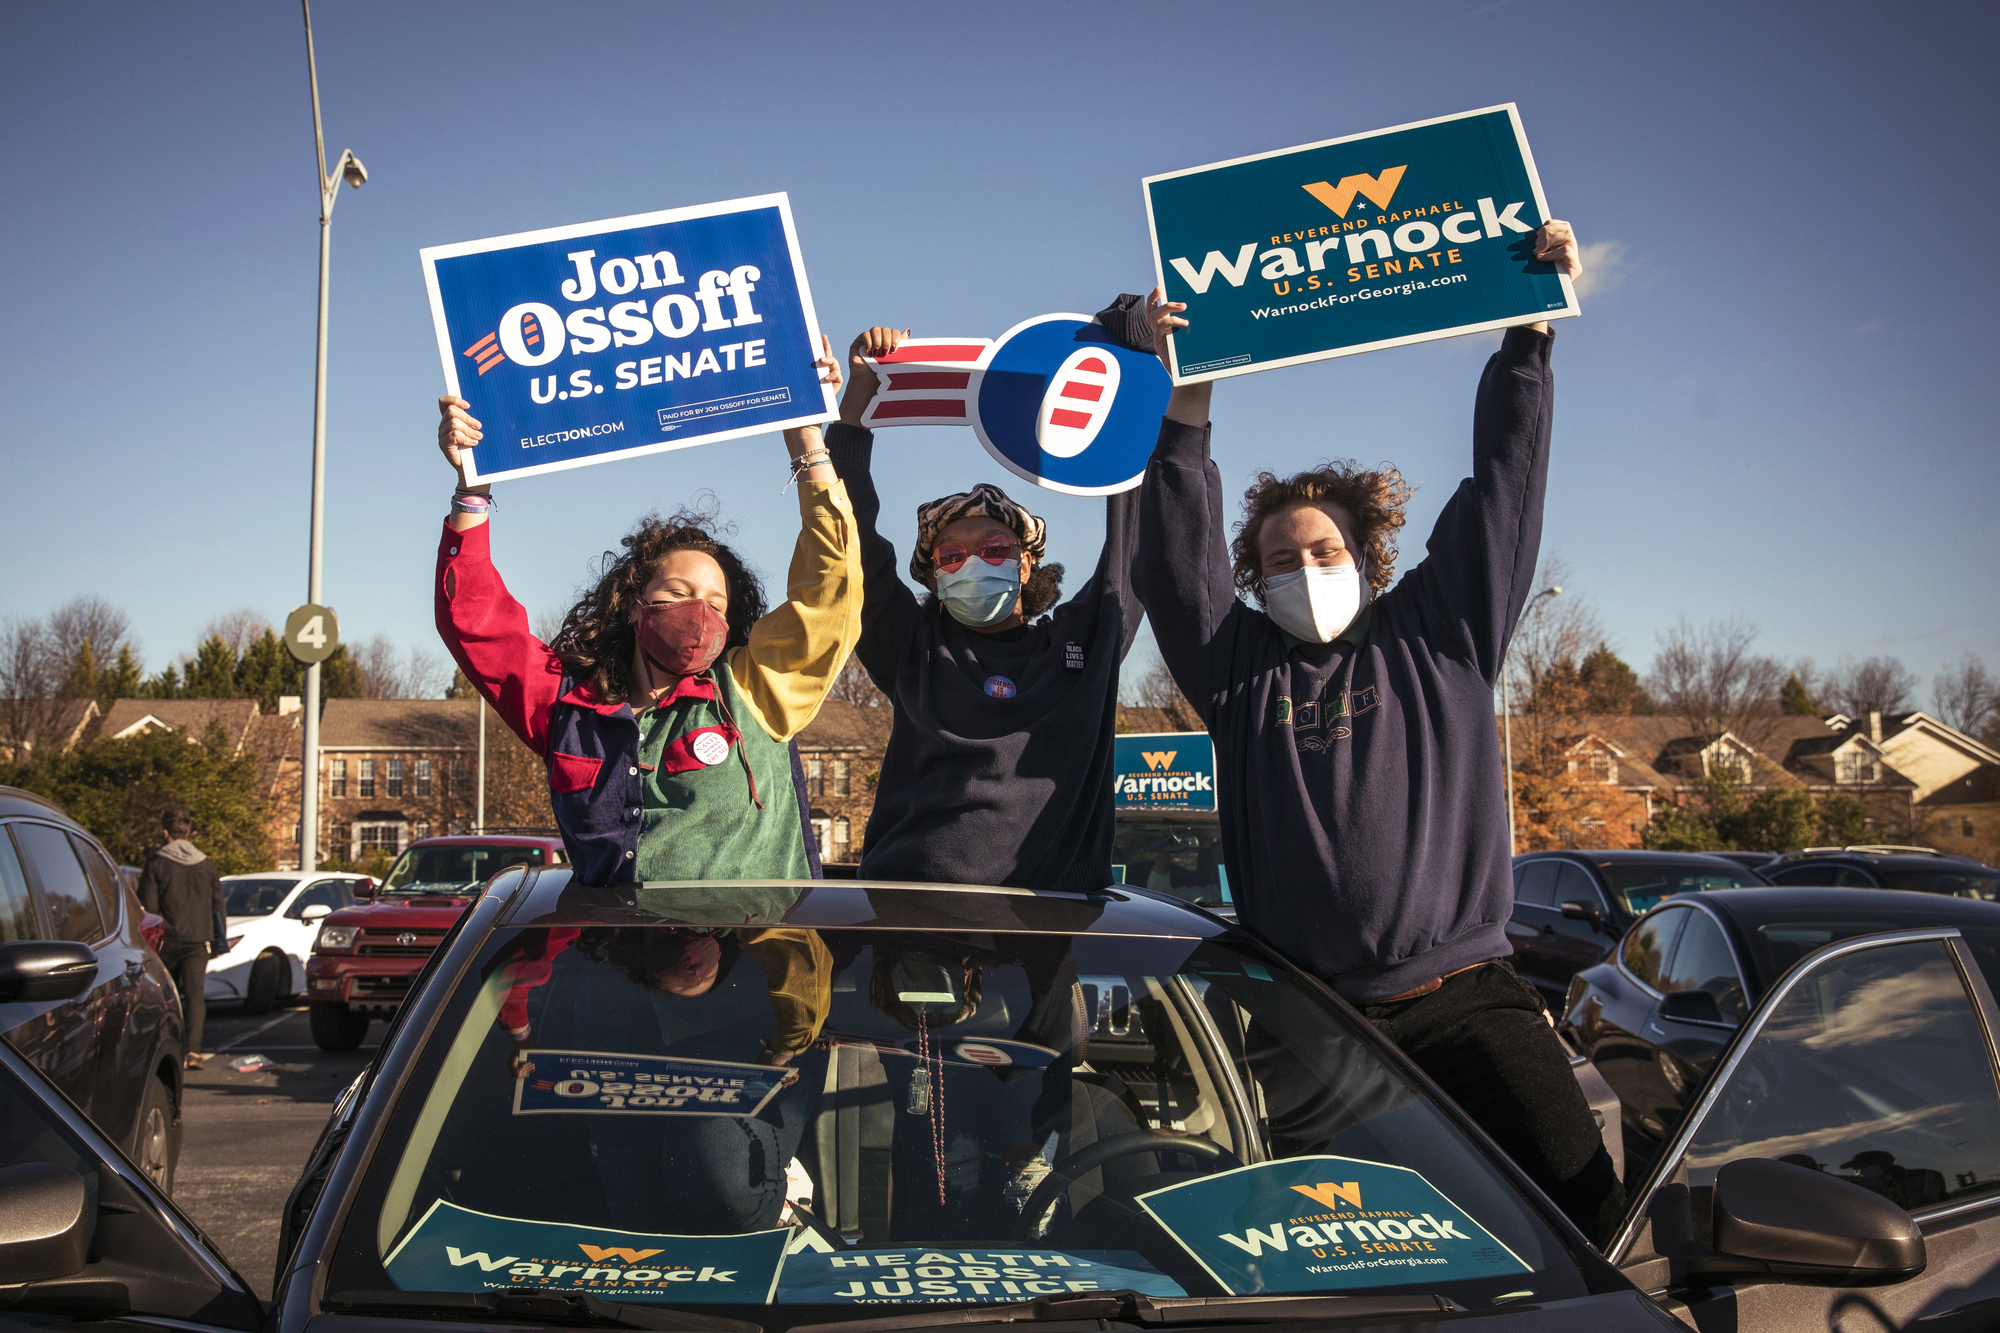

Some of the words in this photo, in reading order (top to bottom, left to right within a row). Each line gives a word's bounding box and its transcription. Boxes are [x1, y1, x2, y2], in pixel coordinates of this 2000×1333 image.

[1271, 219, 1368, 245] REVEREND
[1377, 200, 1464, 225] RAPHAEL
[1169, 197, 1535, 295] Warnock
[561, 249, 684, 302] Jon
[1274, 275, 1333, 296] U.S.
[1347, 248, 1463, 283] SENATE
[1250, 272, 1467, 321] WarnockForGeorgia.com
[498, 265, 762, 367] Ossoff
[530, 369, 604, 404] U.S.
[615, 339, 767, 391] SENATE
[662, 412, 680, 420] PAID
[680, 409, 695, 417] FOR
[705, 405, 719, 413] JON
[719, 400, 746, 410] OSSOFF
[761, 392, 787, 403] SENATE
[520, 420, 625, 449] ELECTJON.COM
[297, 615, 327, 649] 4
[1065, 652, 1084, 660] LIVES
[1066, 645, 1083, 653] BLACK
[1066, 659, 1084, 669] MATTER
[988, 678, 1015, 690] SCIENCE
[696, 735, 718, 752] NASTY
[1127, 793, 1147, 801] U.S.
[1151, 791, 1188, 800] SENATE
[1289, 1211, 1356, 1225] REVEREND
[1359, 1210, 1415, 1219] RAPHAEL
[1218, 1213, 1472, 1257] Warnock
[1311, 1246, 1357, 1259] U.S.
[1361, 1241, 1437, 1254] SENATE
[445, 1245, 738, 1282] Warnock
[530, 1257, 612, 1269] REVEREND
[619, 1263, 691, 1271] RAPHAEL
[829, 1253, 1092, 1268] HEALTH.
[1305, 1256, 1448, 1275] WarnockForGeorgia.com
[511, 1275, 560, 1285] U.S.
[572, 1279, 669, 1288] SENATE
[879, 1266, 1061, 1280] JOBS.
